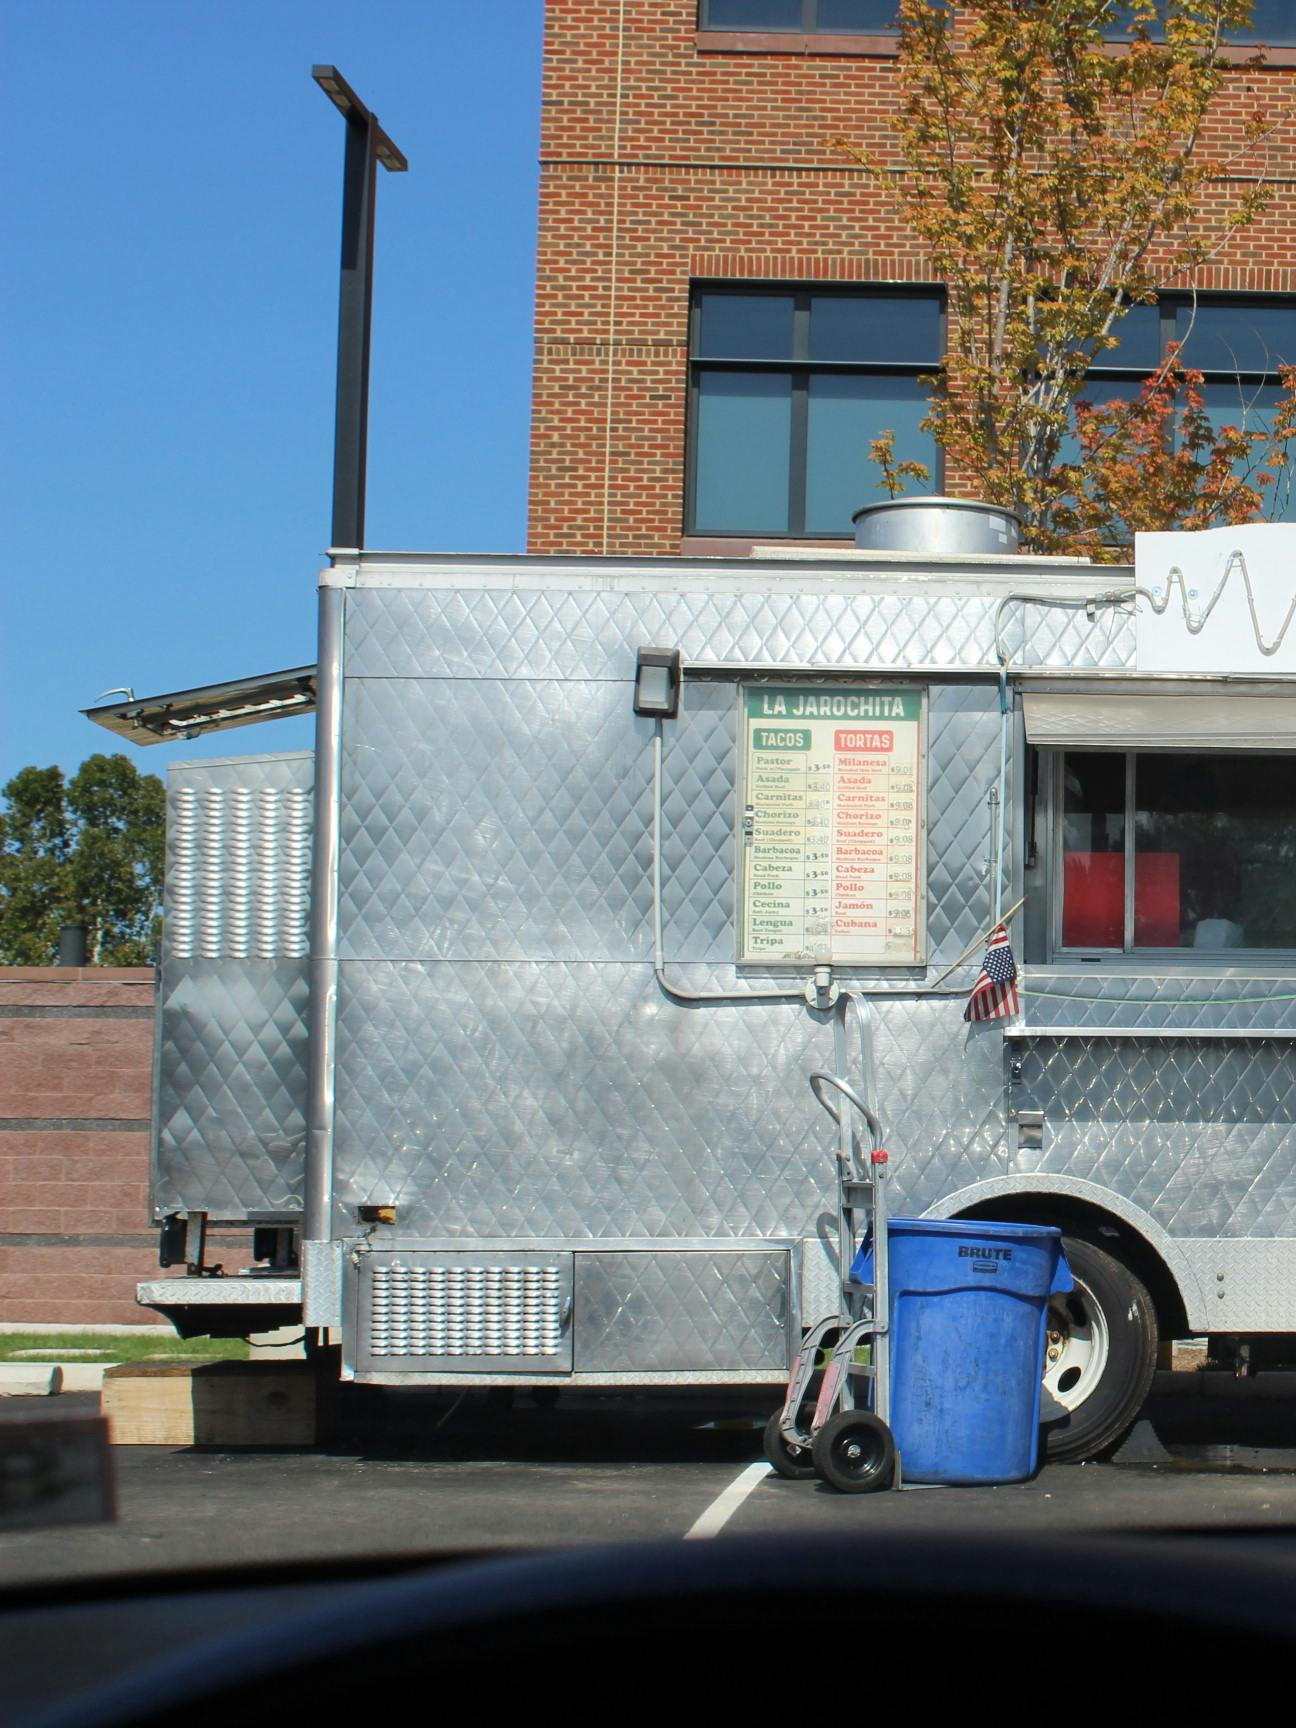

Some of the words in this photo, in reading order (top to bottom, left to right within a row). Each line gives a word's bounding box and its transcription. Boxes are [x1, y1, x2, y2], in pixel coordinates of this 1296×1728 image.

[763, 695, 787, 715] LA
[792, 695, 905, 717] JAROCHITA
[760, 732, 804, 747] TACOS
[838, 733, 890, 748] TORTAS
[756, 756, 793, 765] Pastor
[838, 757, 887, 767] Milanesa
[756, 775, 790, 783] Asada
[838, 776, 872, 785] Asada
[755, 792, 804, 801] Carnitas
[837, 793, 886, 802] Carnitas
[754, 809, 799, 819] Chorizo
[837, 811, 882, 820] Chorizo
[754, 827, 801, 836] Suadero
[836, 829, 884, 838] Suadero
[753, 845, 801, 854] Barbacoa
[836, 847, 884, 855] Barbacoa
[753, 863, 793, 872] Cabeza
[835, 865, 875, 873] Cabeza
[752, 881, 783, 890] Pollo
[835, 883, 865, 892] Pollo
[752, 899, 791, 908] Cecina
[835, 901, 873, 909] Jamón
[752, 917, 793, 928] Lengua
[835, 919, 878, 928] Cubana
[751, 936, 784, 946] Tripa
[959, 1246, 1013, 1260] BRUTE
